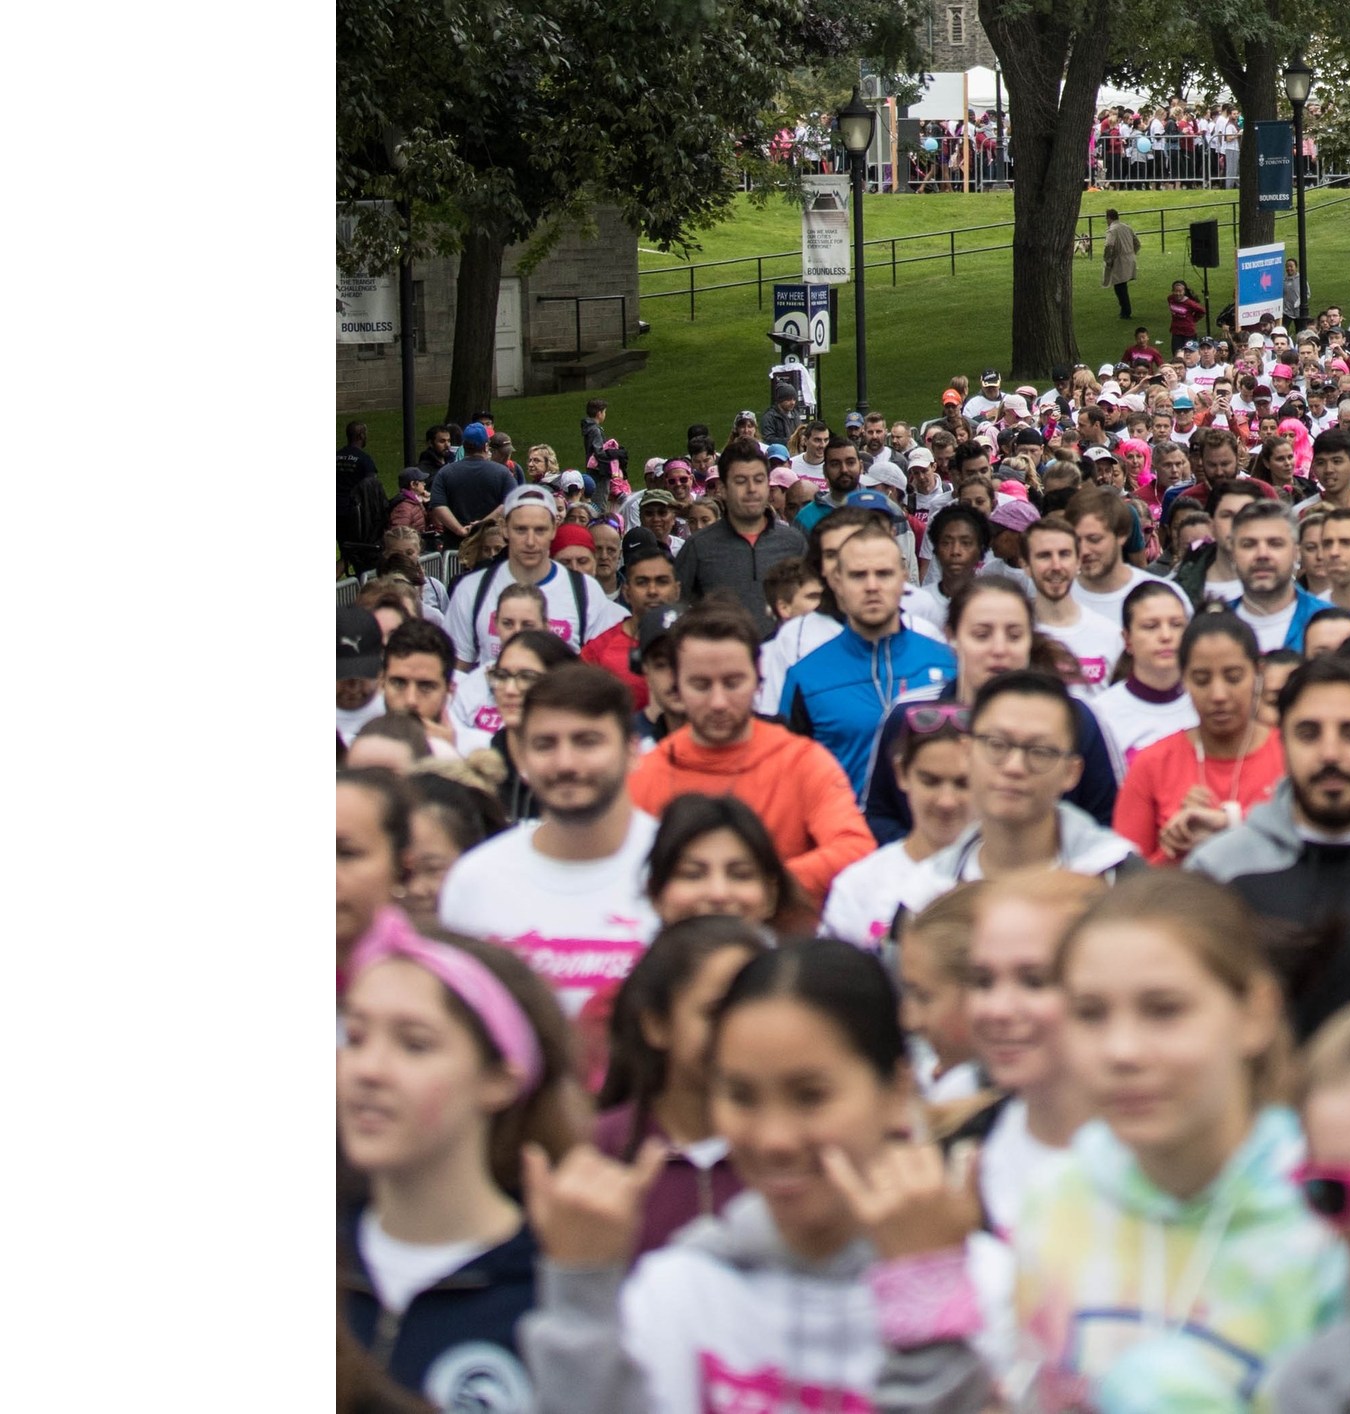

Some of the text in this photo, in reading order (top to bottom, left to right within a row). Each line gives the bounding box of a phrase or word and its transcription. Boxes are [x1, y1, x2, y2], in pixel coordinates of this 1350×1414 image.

[1259, 193, 1290, 202] BOUNDLESS
[807, 267, 846, 275] BOUNDLESS
[777, 291, 804, 300] PAY HERE
[818, 290, 827, 299] HERE
[341, 321, 393, 333] BOUNDLESS
